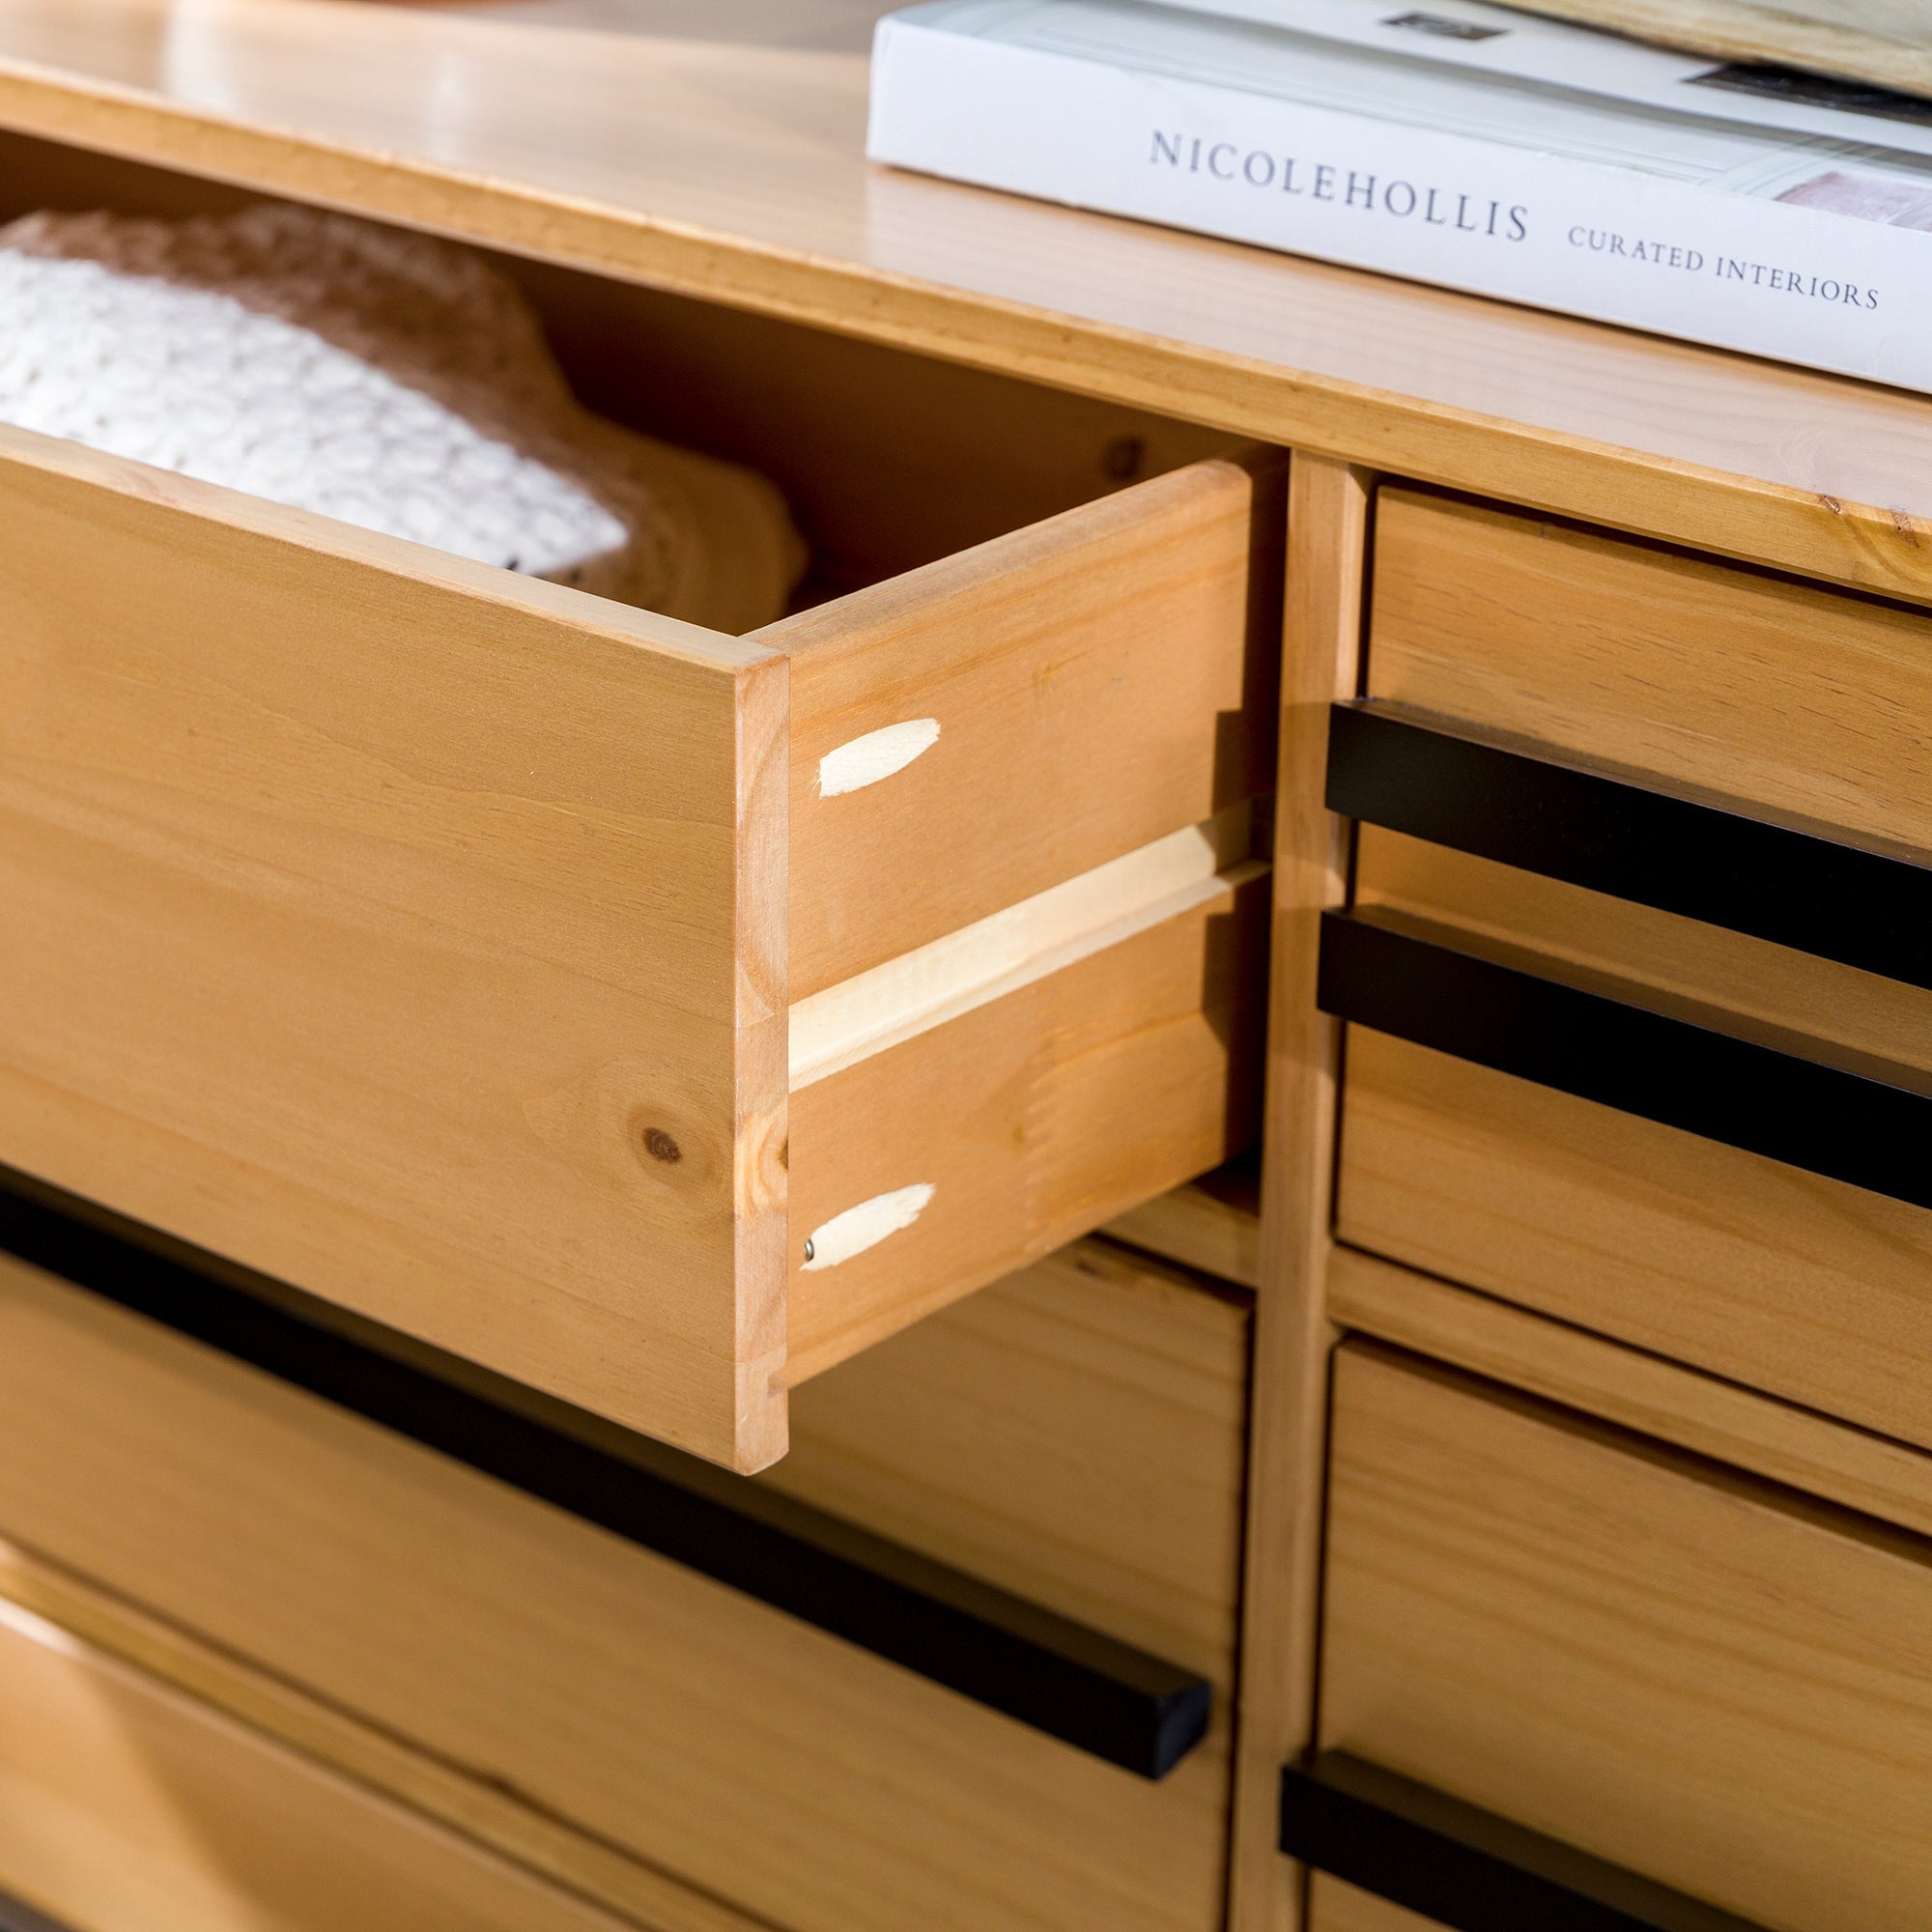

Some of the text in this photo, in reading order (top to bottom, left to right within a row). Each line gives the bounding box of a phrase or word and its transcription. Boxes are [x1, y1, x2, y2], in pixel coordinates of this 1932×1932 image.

[1150, 130, 1879, 310] NICOLEHOLLIS CURATED INTERIORS
